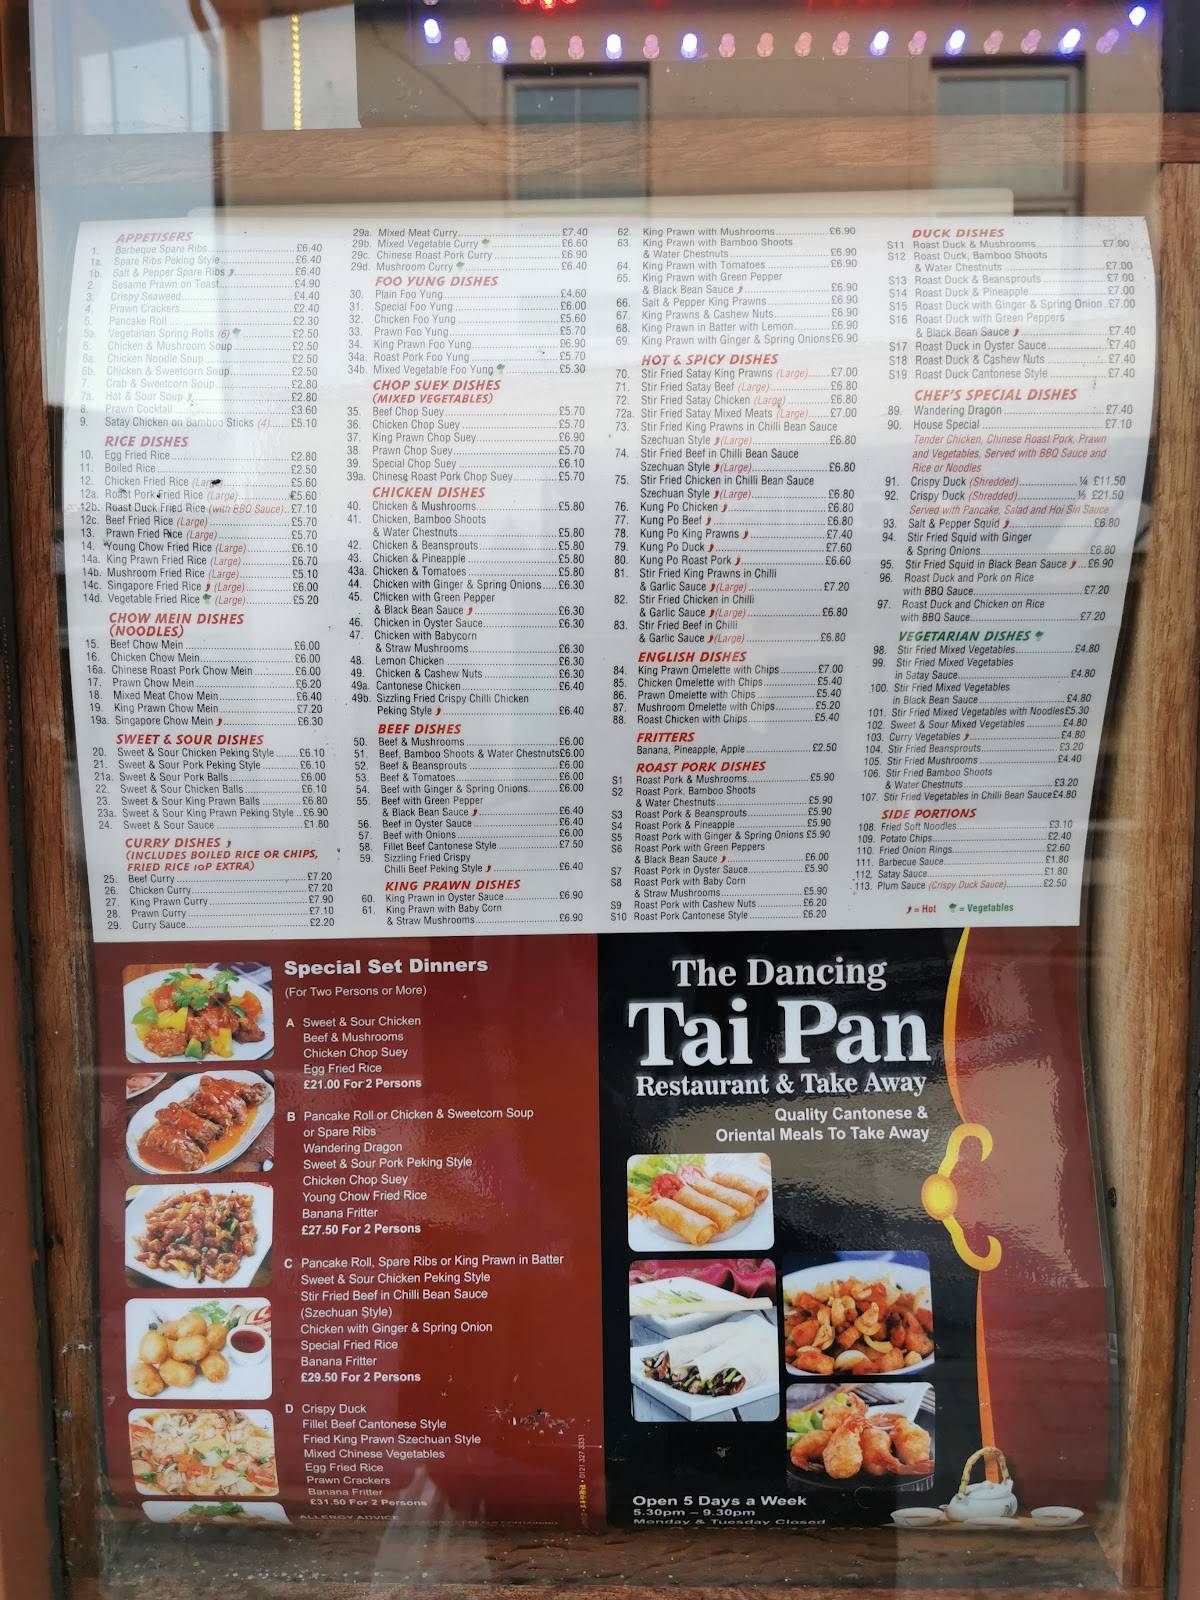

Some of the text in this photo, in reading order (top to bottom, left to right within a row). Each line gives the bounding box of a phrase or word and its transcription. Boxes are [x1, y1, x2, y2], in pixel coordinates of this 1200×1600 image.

[115, 232, 193, 244] APPETISERS
[912, 228, 1005, 238] DUCK DISHES
[375, 276, 499, 287] FOO YUNG DISHES
[374, 313, 410, 326] Chicken
[412, 313, 430, 325] Foo
[432, 313, 456, 326] Yung
[560, 313, 587, 323] £5.60
[640, 353, 779, 367] HOT & SPICY DISHES
[373, 379, 501, 391] CHOP SUEY DISHES
[372, 392, 493, 405] (MIXED VEGETABLES)
[965, 389, 1022, 401] SPECIAL
[1026, 388, 1078, 401] DISHES
[104, 435, 189, 448] RICE DISHES
[372, 486, 486, 498] CHICKEN DISHES
[109, 612, 244, 626] CHOW MEIN DISHES
[109, 624, 184, 639] (NOODLES)
[899, 630, 1032, 642] VEGETARIAN DISHES
[638, 651, 747, 663] ENGLISH DISHES
[378, 724, 462, 735] BEEF DISHES
[116, 734, 264, 745] SWEET & SOUR DISHES
[636, 732, 695, 743] FRITTERS
[720, 744, 745, 755] Apple
[812, 742, 837, 752] £2.50
[636, 761, 766, 773] ROAST PORK DISHES
[881, 808, 977, 820] SIDE PORTIONS
[125, 837, 221, 848] CURRY DISHES
[880, 834, 907, 843] Potato
[909, 833, 933, 844] Chips
[1048, 831, 1072, 841] £2.40
[126, 849, 318, 861] (INCLUDES BOILED RICE OR CHIPS,
[127, 863, 160, 872] FRIED
[164, 862, 190, 871] RICE
[215, 860, 255, 871] EXTRA)
[385, 879, 521, 891] KING PRAWN DISHES
[922, 903, 1014, 914] Hot Vegetables
[610, 909, 827, 922] S10 Roast Pork Cantonese Style £6.20
[132, 918, 157, 931] Curry
[159, 920, 187, 929] Sauce
[309, 917, 335, 927] £2.20
[284, 958, 488, 978] Special Set Dinners
[672, 956, 888, 991] The Dancing
[285, 985, 427, 999] (For Two Persons or More)
[286, 1016, 421, 1028] A Sweet & Sour Chicken
[628, 997, 932, 1067] Tai Pan
[303, 1078, 422, 1090] £21.00 For 2 Persons
[635, 1071, 927, 1099] Restaurant & Take Away
[287, 1107, 534, 1122] B Pancake Roll or Chicken & Sweetcorn Soup
[775, 1105, 928, 1124] Quality Cantonese &
[716, 1126, 930, 1144] Oriental Meals To Take Away
[303, 1142, 402, 1155] Wandering Dragon
[284, 1254, 564, 1269] C Pancake Roll, Spare Ribs or King Prawn in Batter
[285, 1403, 367, 1416] D Crispy Duck
[304, 1448, 446, 1461] Mixed Chinese Vegetables
[633, 1496, 807, 1508] Open 5 Days a Week
[633, 1507, 685, 1517] 5.30pm
[703, 1508, 755, 1517] 9.30pm
[633, 1518, 690, 1526] Monday
